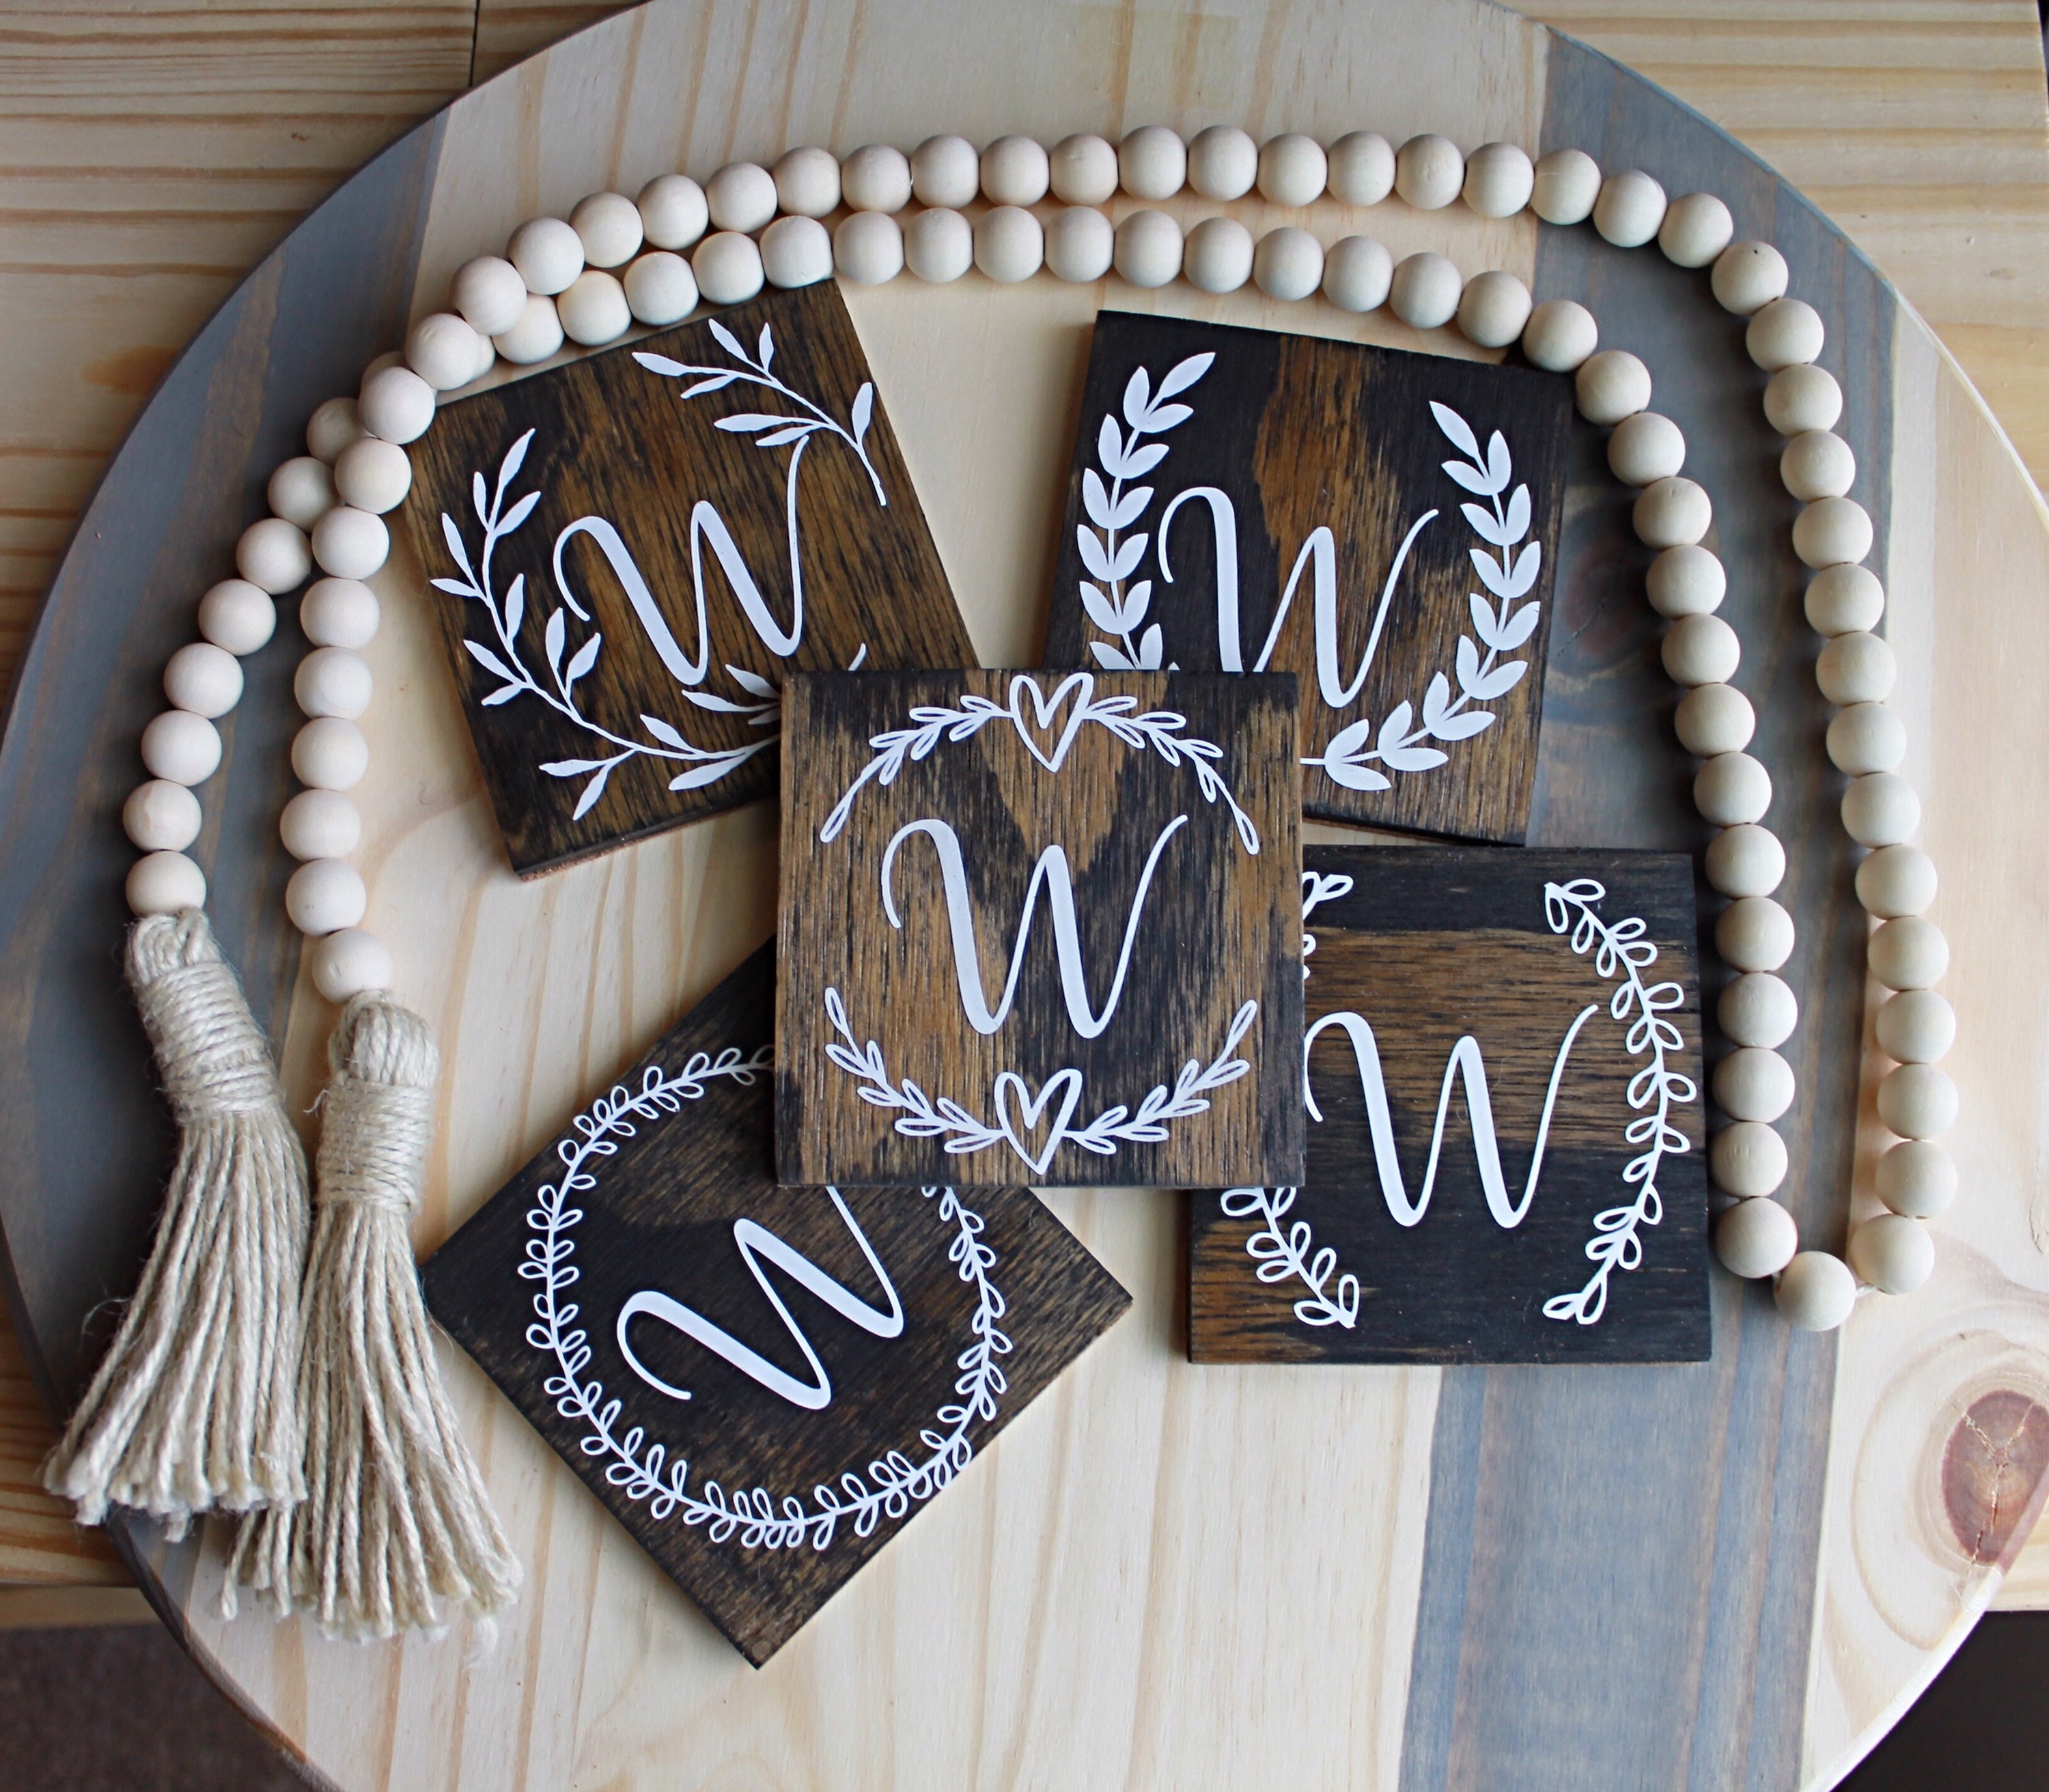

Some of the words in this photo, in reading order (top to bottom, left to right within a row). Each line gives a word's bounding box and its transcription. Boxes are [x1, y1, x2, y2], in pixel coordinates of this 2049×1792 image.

[553, 434, 809, 686] W
[1158, 486, 1439, 708] W
[881, 814, 1188, 1039] W
[1303, 1004, 1599, 1229] W
[616, 1186, 904, 1410] W
